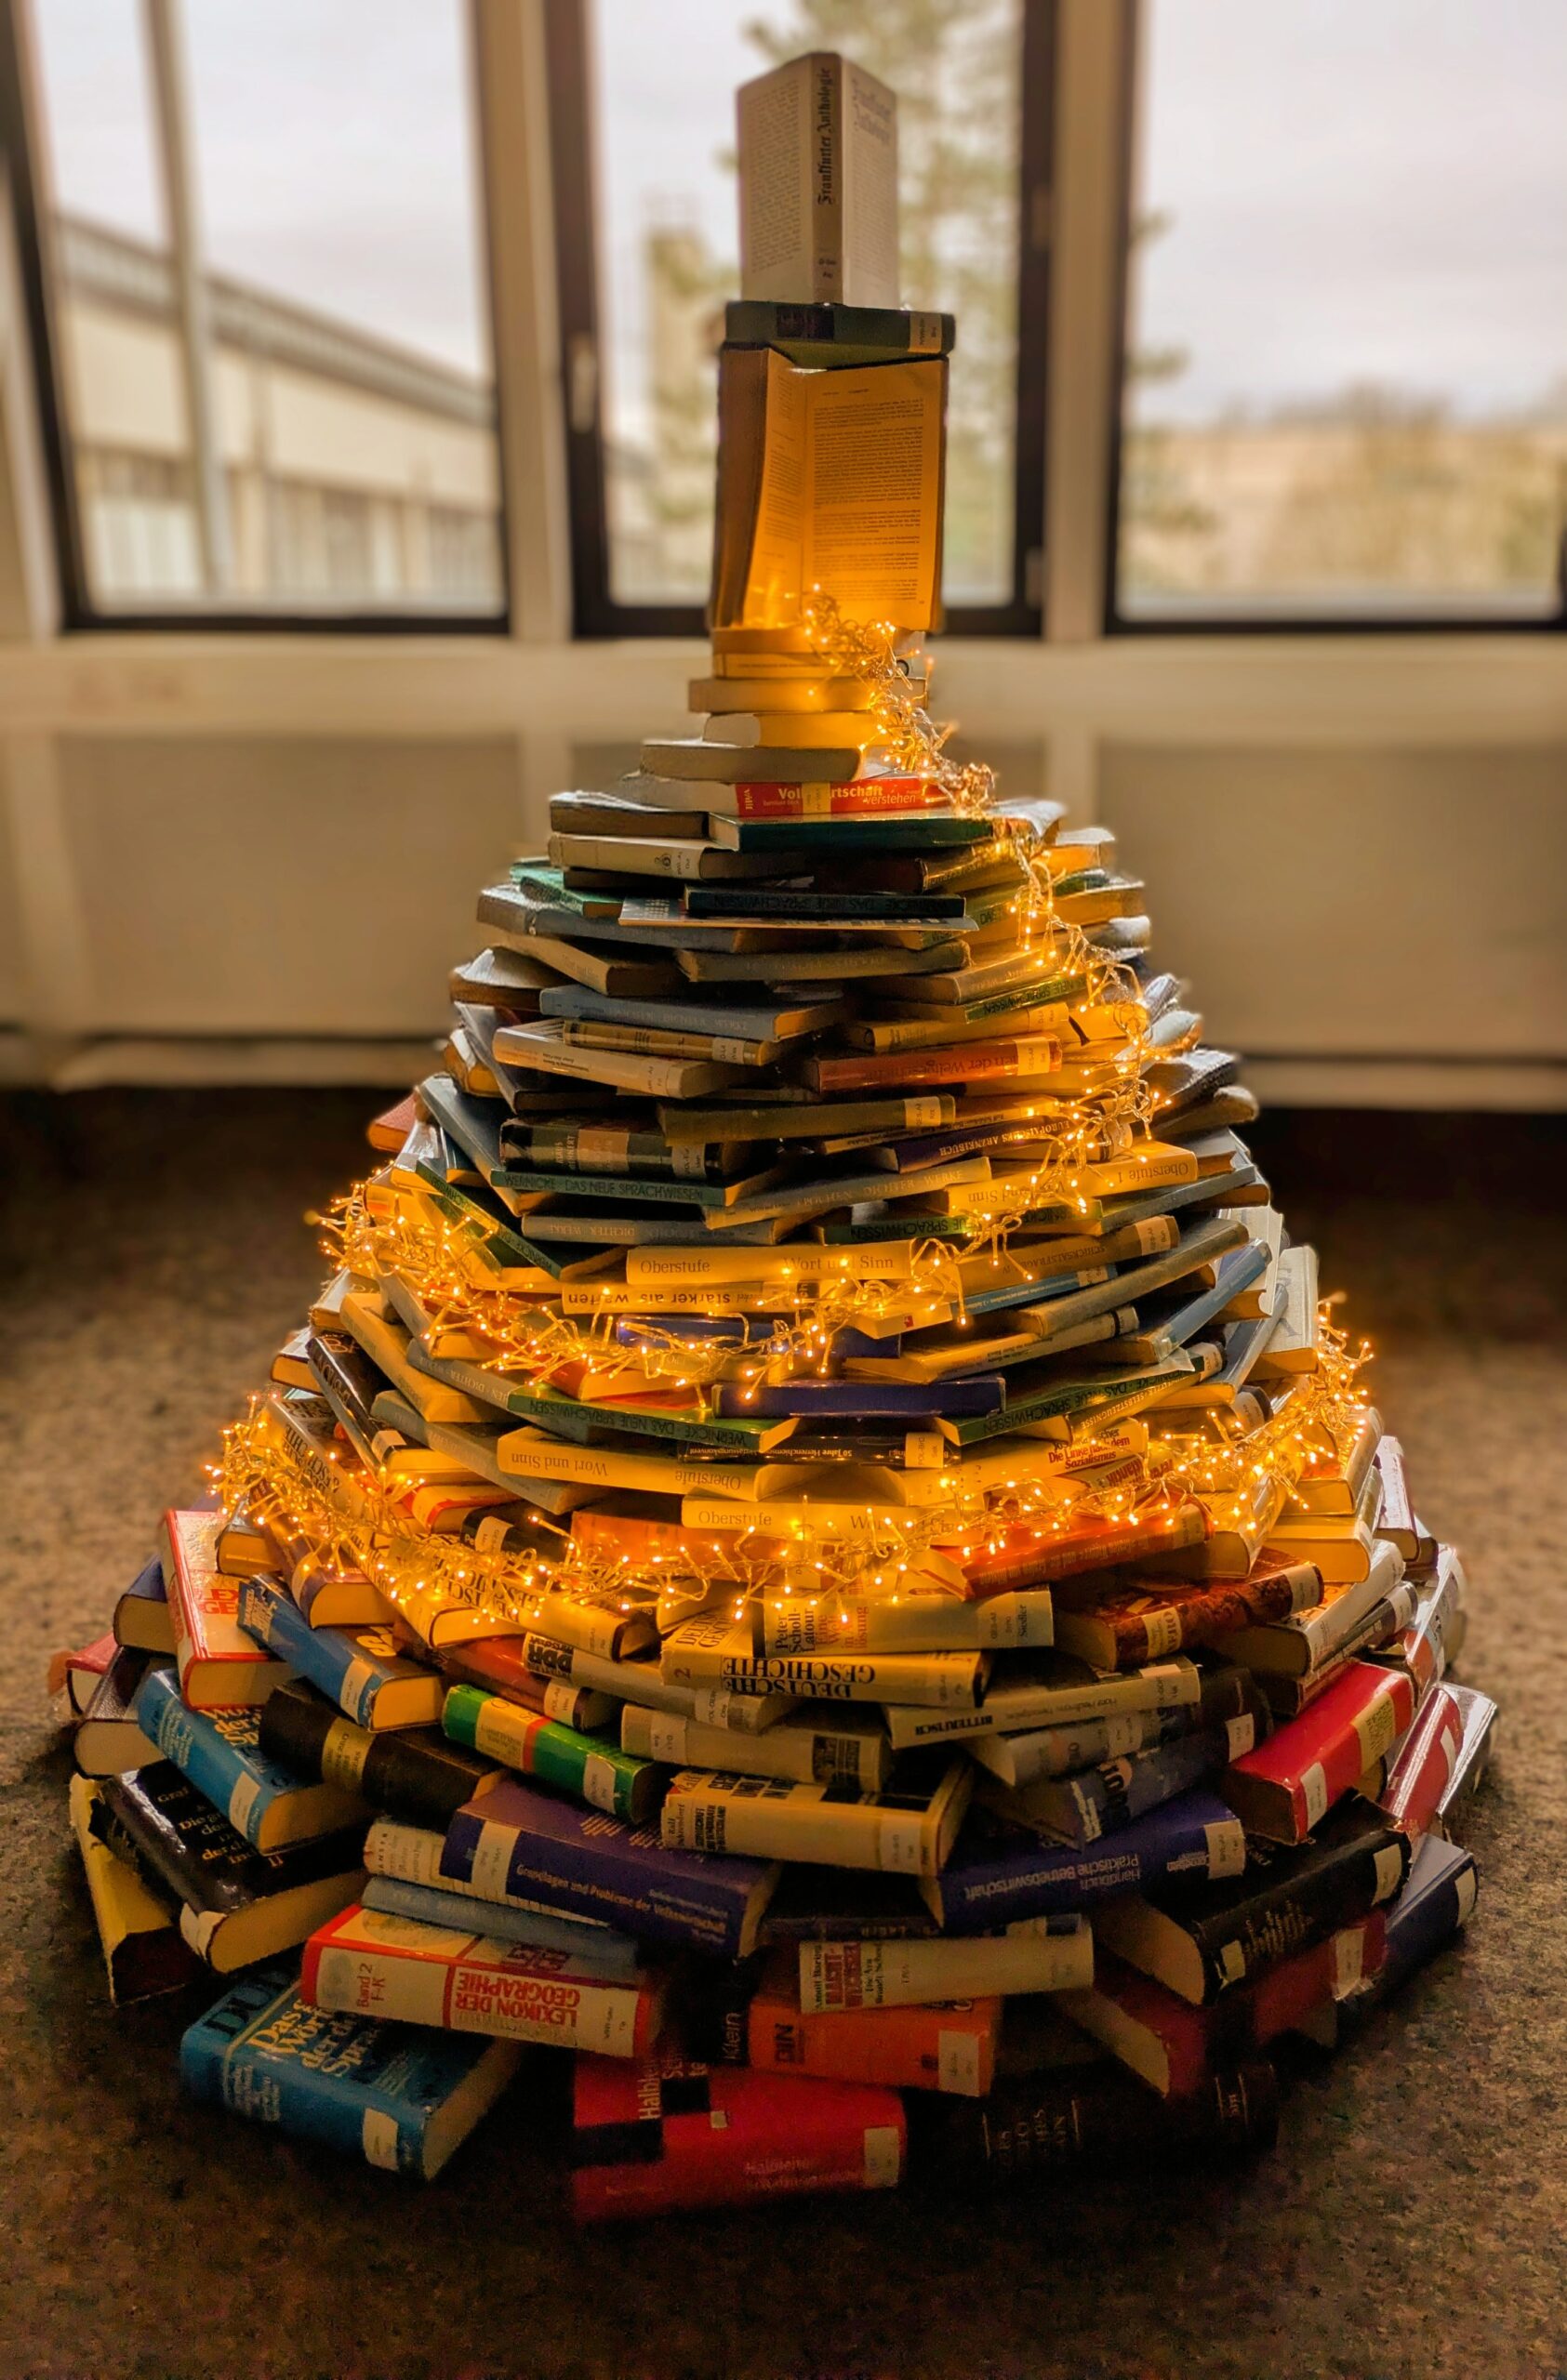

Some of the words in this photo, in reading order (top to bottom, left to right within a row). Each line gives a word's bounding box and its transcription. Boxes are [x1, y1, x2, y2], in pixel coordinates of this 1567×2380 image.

[817, 68, 835, 134] Anthologie
[817, 137, 834, 205] Frankfurter
[778, 785, 883, 800] Volrtschaft
[505, 1175, 556, 1191] WERNICKE
[564, 1179, 587, 1194] DAS
[589, 1181, 616, 1196] NEUE
[618, 1183, 703, 1202] SPRACHWISSEN
[640, 1259, 710, 1275] Oberstufe
[860, 1256, 894, 1270] Sinn
[529, 1399, 616, 1427] SPRACHWISSEN
[983, 1398, 1070, 1432] SPRACHWISSEN
[650, 1421, 675, 1435] DAS
[683, 1425, 746, 1445] WERNICKE
[511, 1452, 541, 1469] Sinn
[545, 1454, 570, 1471] und
[578, 1458, 609, 1476] Wort
[1048, 1449, 1064, 1463] Die
[1065, 1450, 1117, 1469] Sozialismus
[675, 1469, 741, 1489] Oberstufe
[697, 1510, 772, 1527] Oberstufe
[776, 1614, 789, 1649] Peter
[790, 1607, 802, 1653] Scholl-
[803, 1607, 816, 1652] Latour
[1017, 1603, 1029, 1638] Siedler
[527, 1645, 574, 1674] DDR
[724, 1657, 876, 1685] GESCHICHTE
[676, 1668, 691, 1679] 2
[723, 1677, 852, 1699] DEUTSCHE
[1077, 1853, 1139, 1876] Praktische
[515, 1863, 568, 1891] Grundlagen
[589, 1884, 633, 1908] Probleme
[963, 1864, 1077, 1901] Betriebswirtschaft
[1080, 1867, 1141, 1891] Handbuch
[359, 1963, 372, 1975] 2
[356, 1977, 371, 2008] Band
[458, 1972, 581, 2008] GEOGRAPHIE
[455, 1992, 493, 2015] DER
[496, 1998, 578, 2028] LEXIKON
